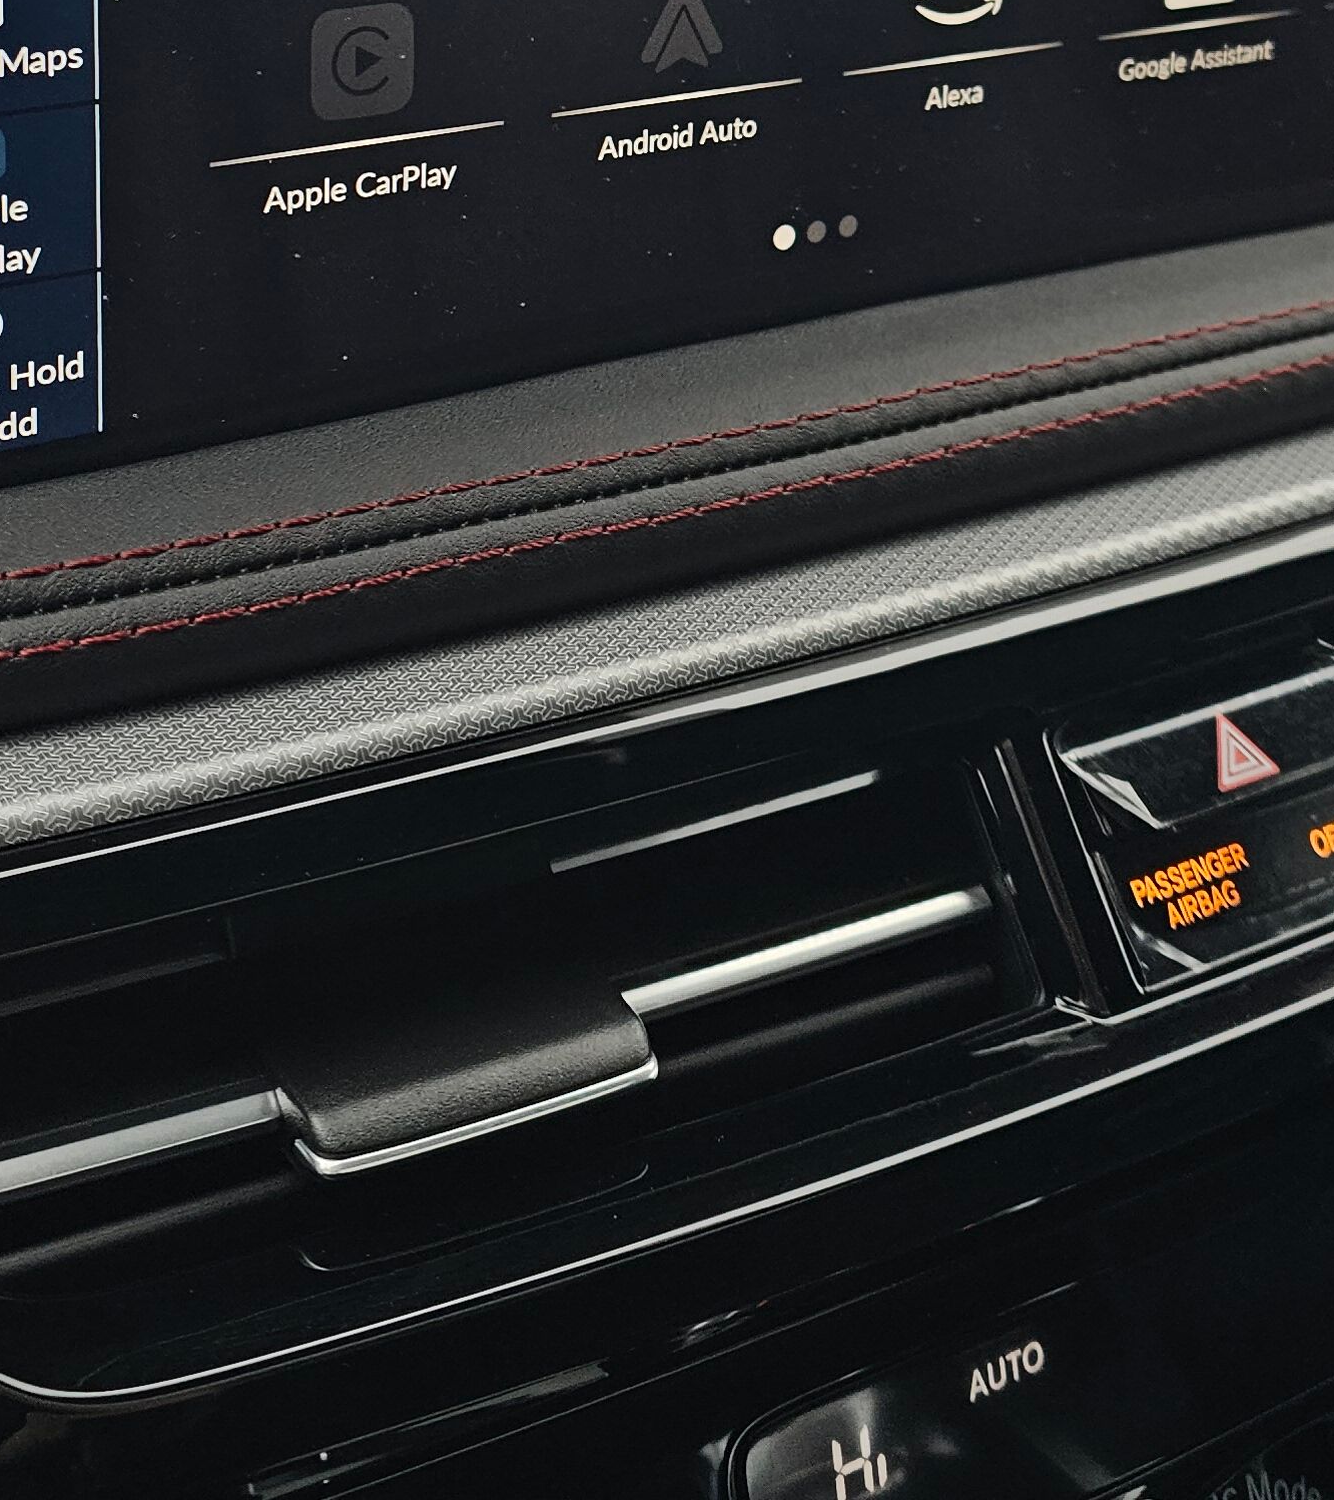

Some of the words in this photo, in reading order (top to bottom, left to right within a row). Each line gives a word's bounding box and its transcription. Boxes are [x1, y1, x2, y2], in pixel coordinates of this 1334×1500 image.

[1118, 50, 1188, 82] Google
[1190, 39, 1275, 71] Assistant
[924, 84, 984, 111] Alexa
[597, 121, 694, 161] Android
[698, 117, 758, 145] Auto
[262, 176, 348, 215] Apple
[355, 162, 458, 198] CarPlay
[10, 350, 85, 391] Hold
[1129, 842, 1250, 909] PASSENGER
[1166, 879, 1241, 930] AIRBAG
[969, 1340, 1045, 1403] AUTO
